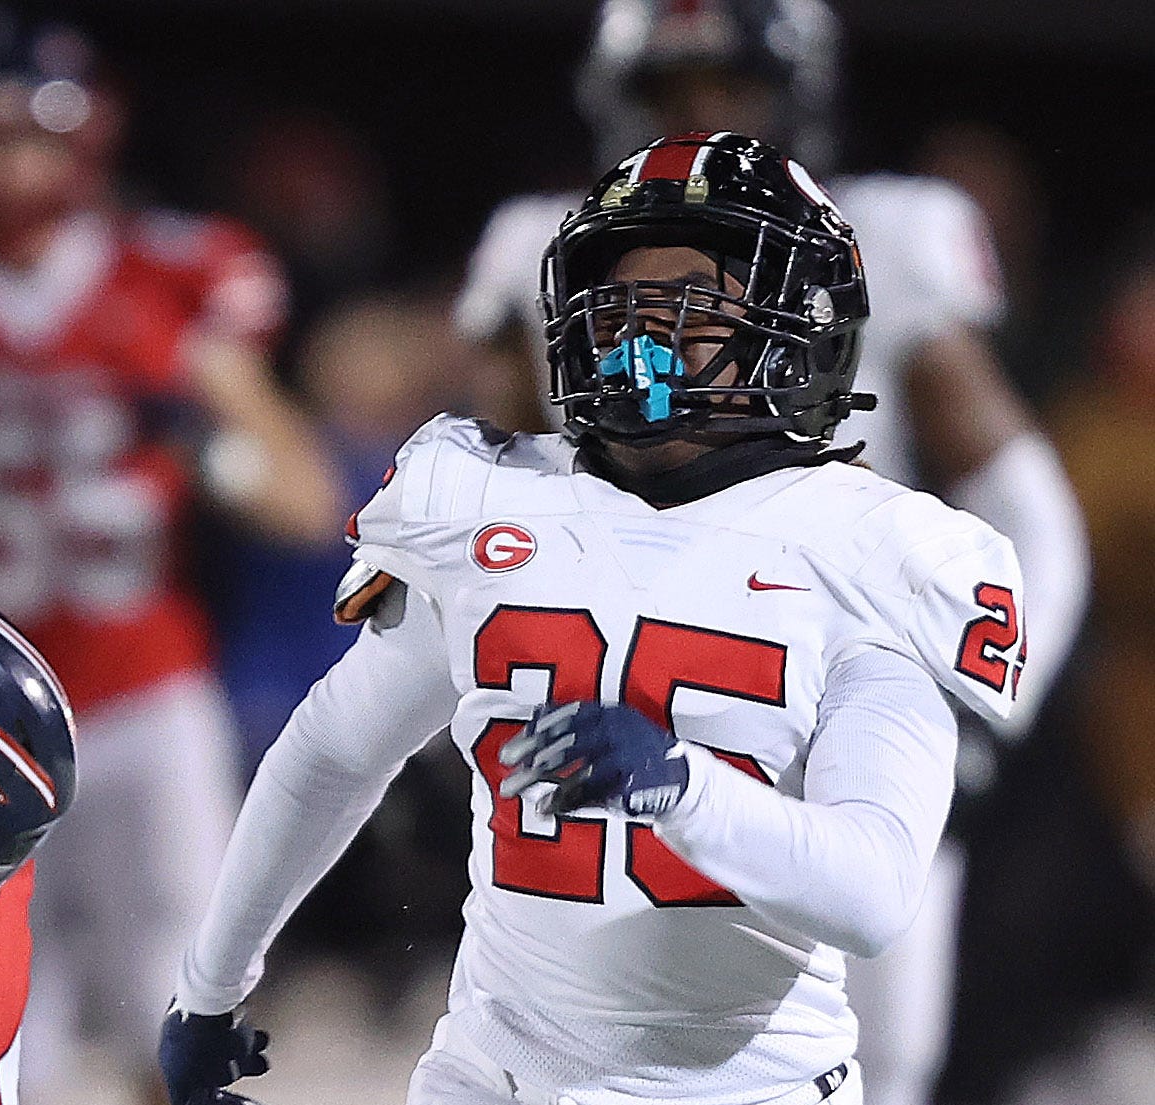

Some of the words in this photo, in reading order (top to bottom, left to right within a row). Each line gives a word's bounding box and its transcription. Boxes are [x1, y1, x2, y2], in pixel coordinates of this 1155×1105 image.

[473, 523, 534, 572] G
[954, 581, 1028, 701] 2
[471, 604, 786, 908] 25
